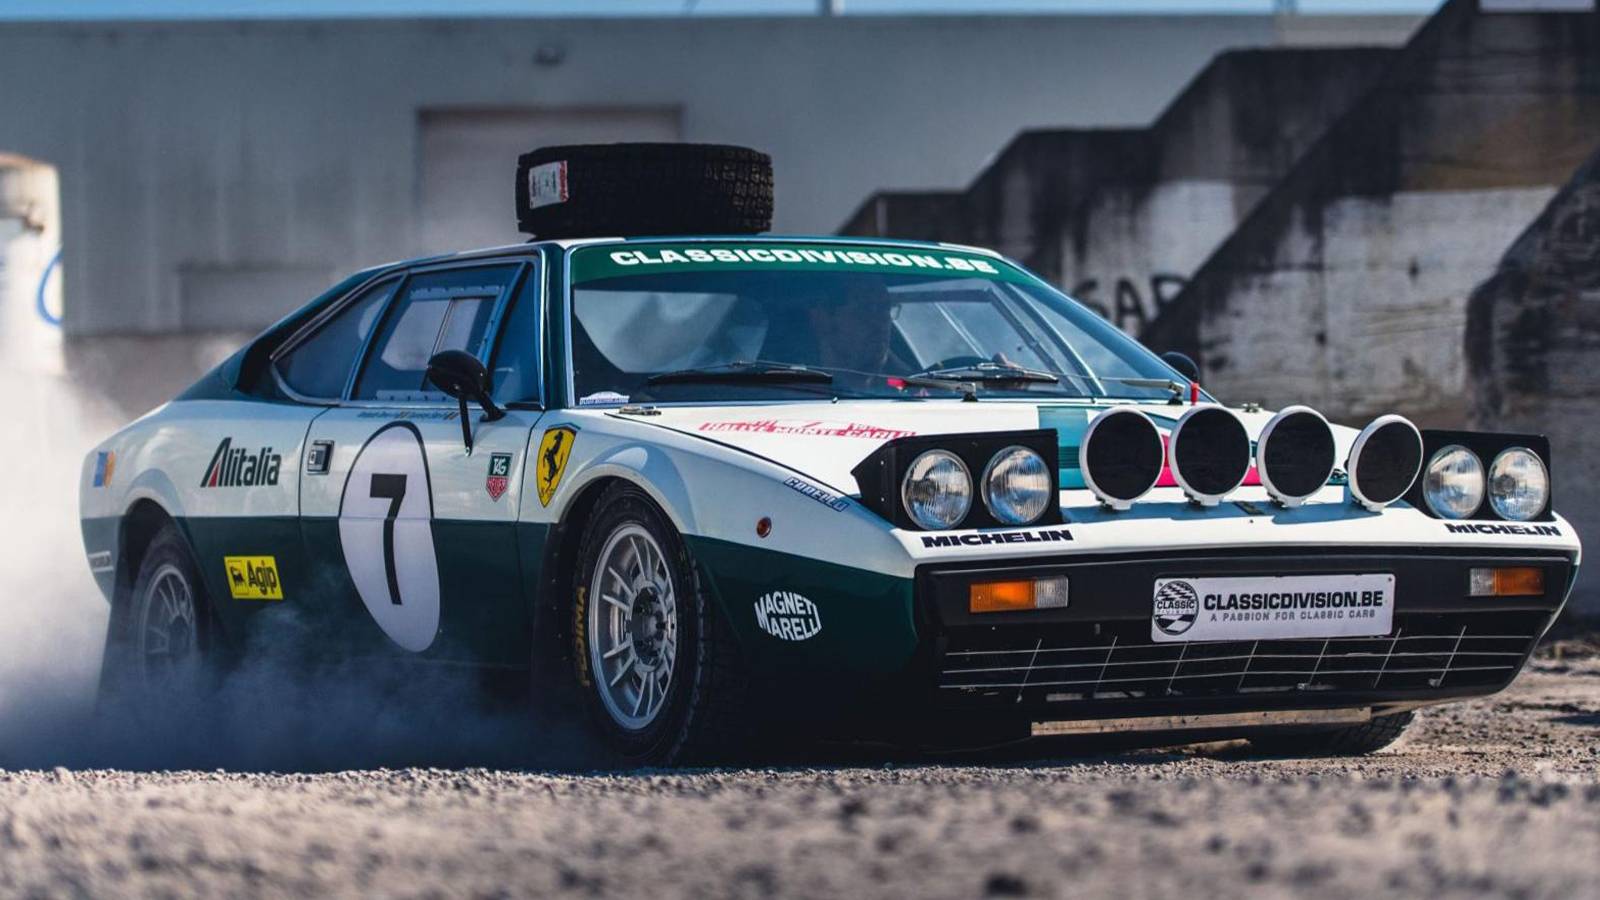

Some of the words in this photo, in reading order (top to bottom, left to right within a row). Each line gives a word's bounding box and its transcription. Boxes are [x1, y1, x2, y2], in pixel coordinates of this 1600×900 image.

[610, 248, 999, 275] CLASSICDIVISION.BE
[200, 437, 282, 488] Alitalia
[492, 457, 508, 475] TAG
[370, 473, 407, 605] 7
[921, 530, 1073, 548] MICHELIN
[1444, 523, 1562, 536] MICHELIN
[247, 560, 278, 595] Agip
[1157, 600, 1195, 610] CLASSIC
[1204, 591, 1383, 611] CLASSICDIVISION.BE
[1210, 613, 1218, 622] A
[1222, 612, 1270, 622] PASSION
[1274, 611, 1296, 621] FOR
[1300, 610, 1344, 620] CLASSIC
[1349, 609, 1376, 619] CARS
